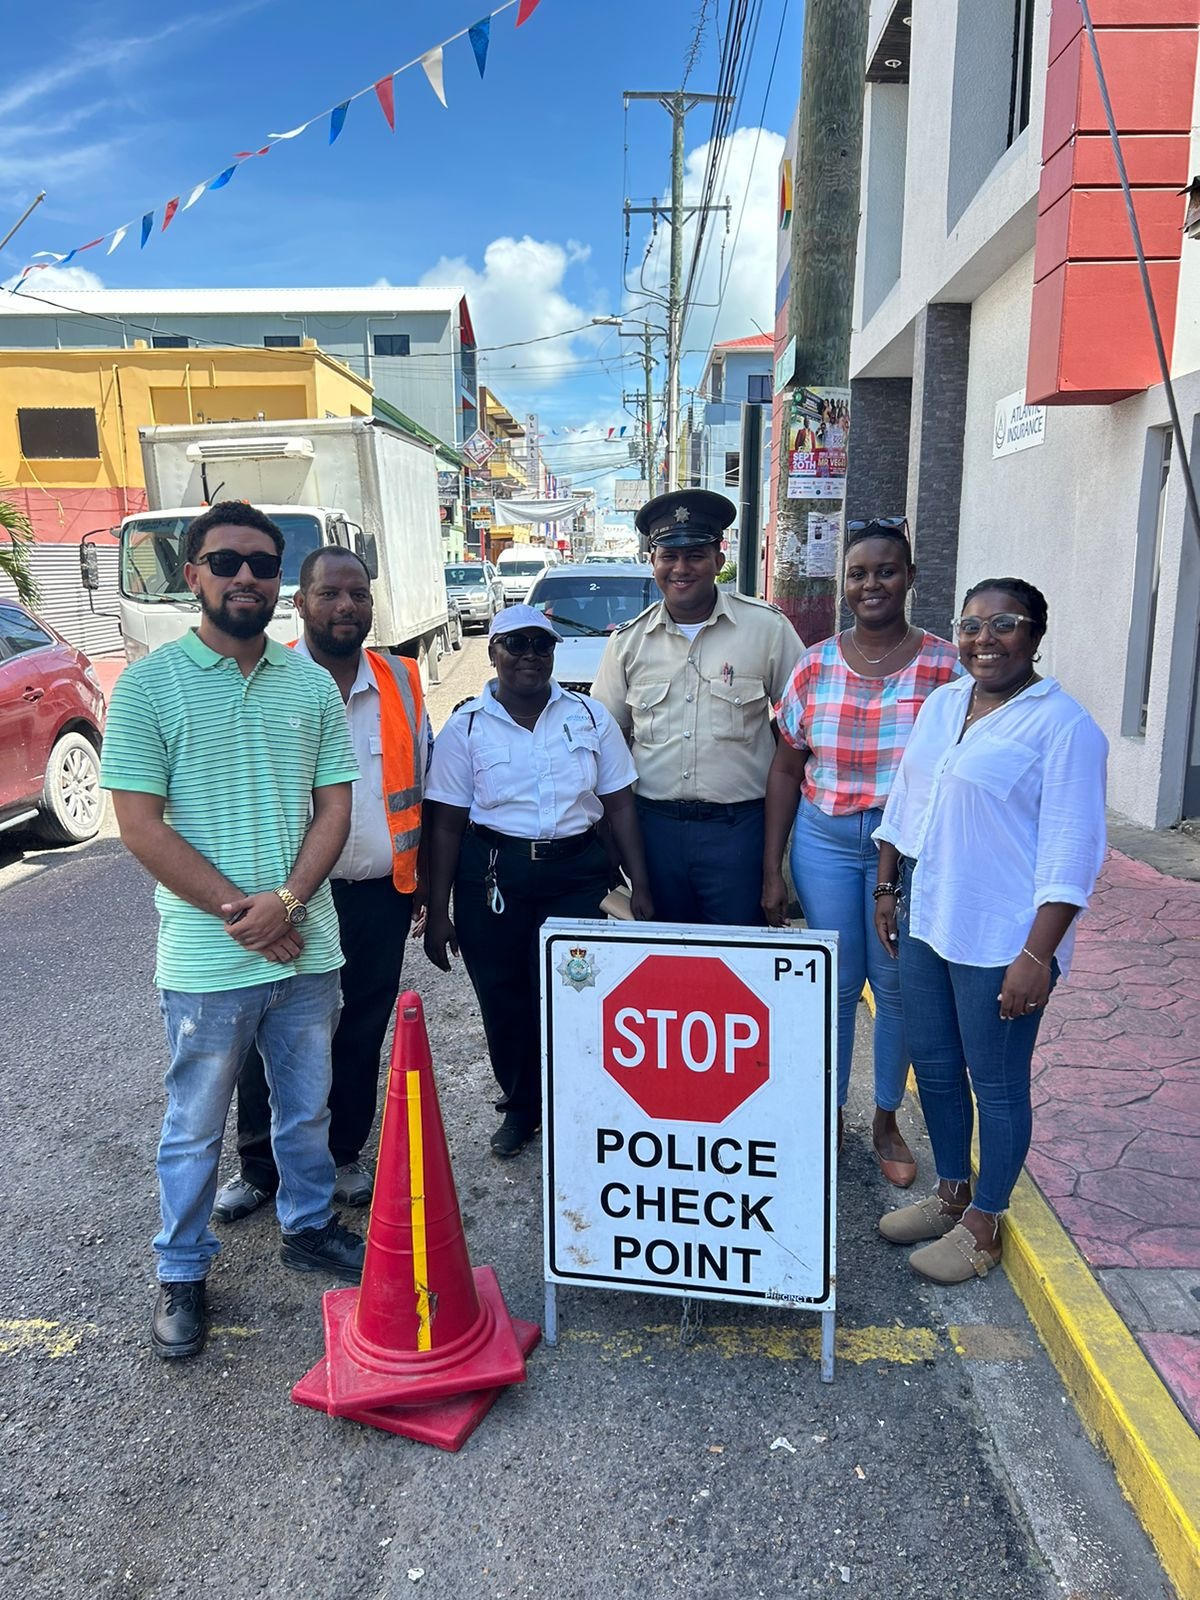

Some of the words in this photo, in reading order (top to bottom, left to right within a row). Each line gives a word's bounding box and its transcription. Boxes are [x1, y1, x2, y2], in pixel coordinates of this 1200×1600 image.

[1007, 416, 1043, 443] INSURANCE
[793, 452, 815, 461] SEPT
[774, 957, 816, 983] P-1
[612, 1007, 760, 1073] STOP
[596, 1128, 777, 1178] POLICE
[600, 1182, 774, 1232] CHECK
[613, 1236, 761, 1283] POINT
